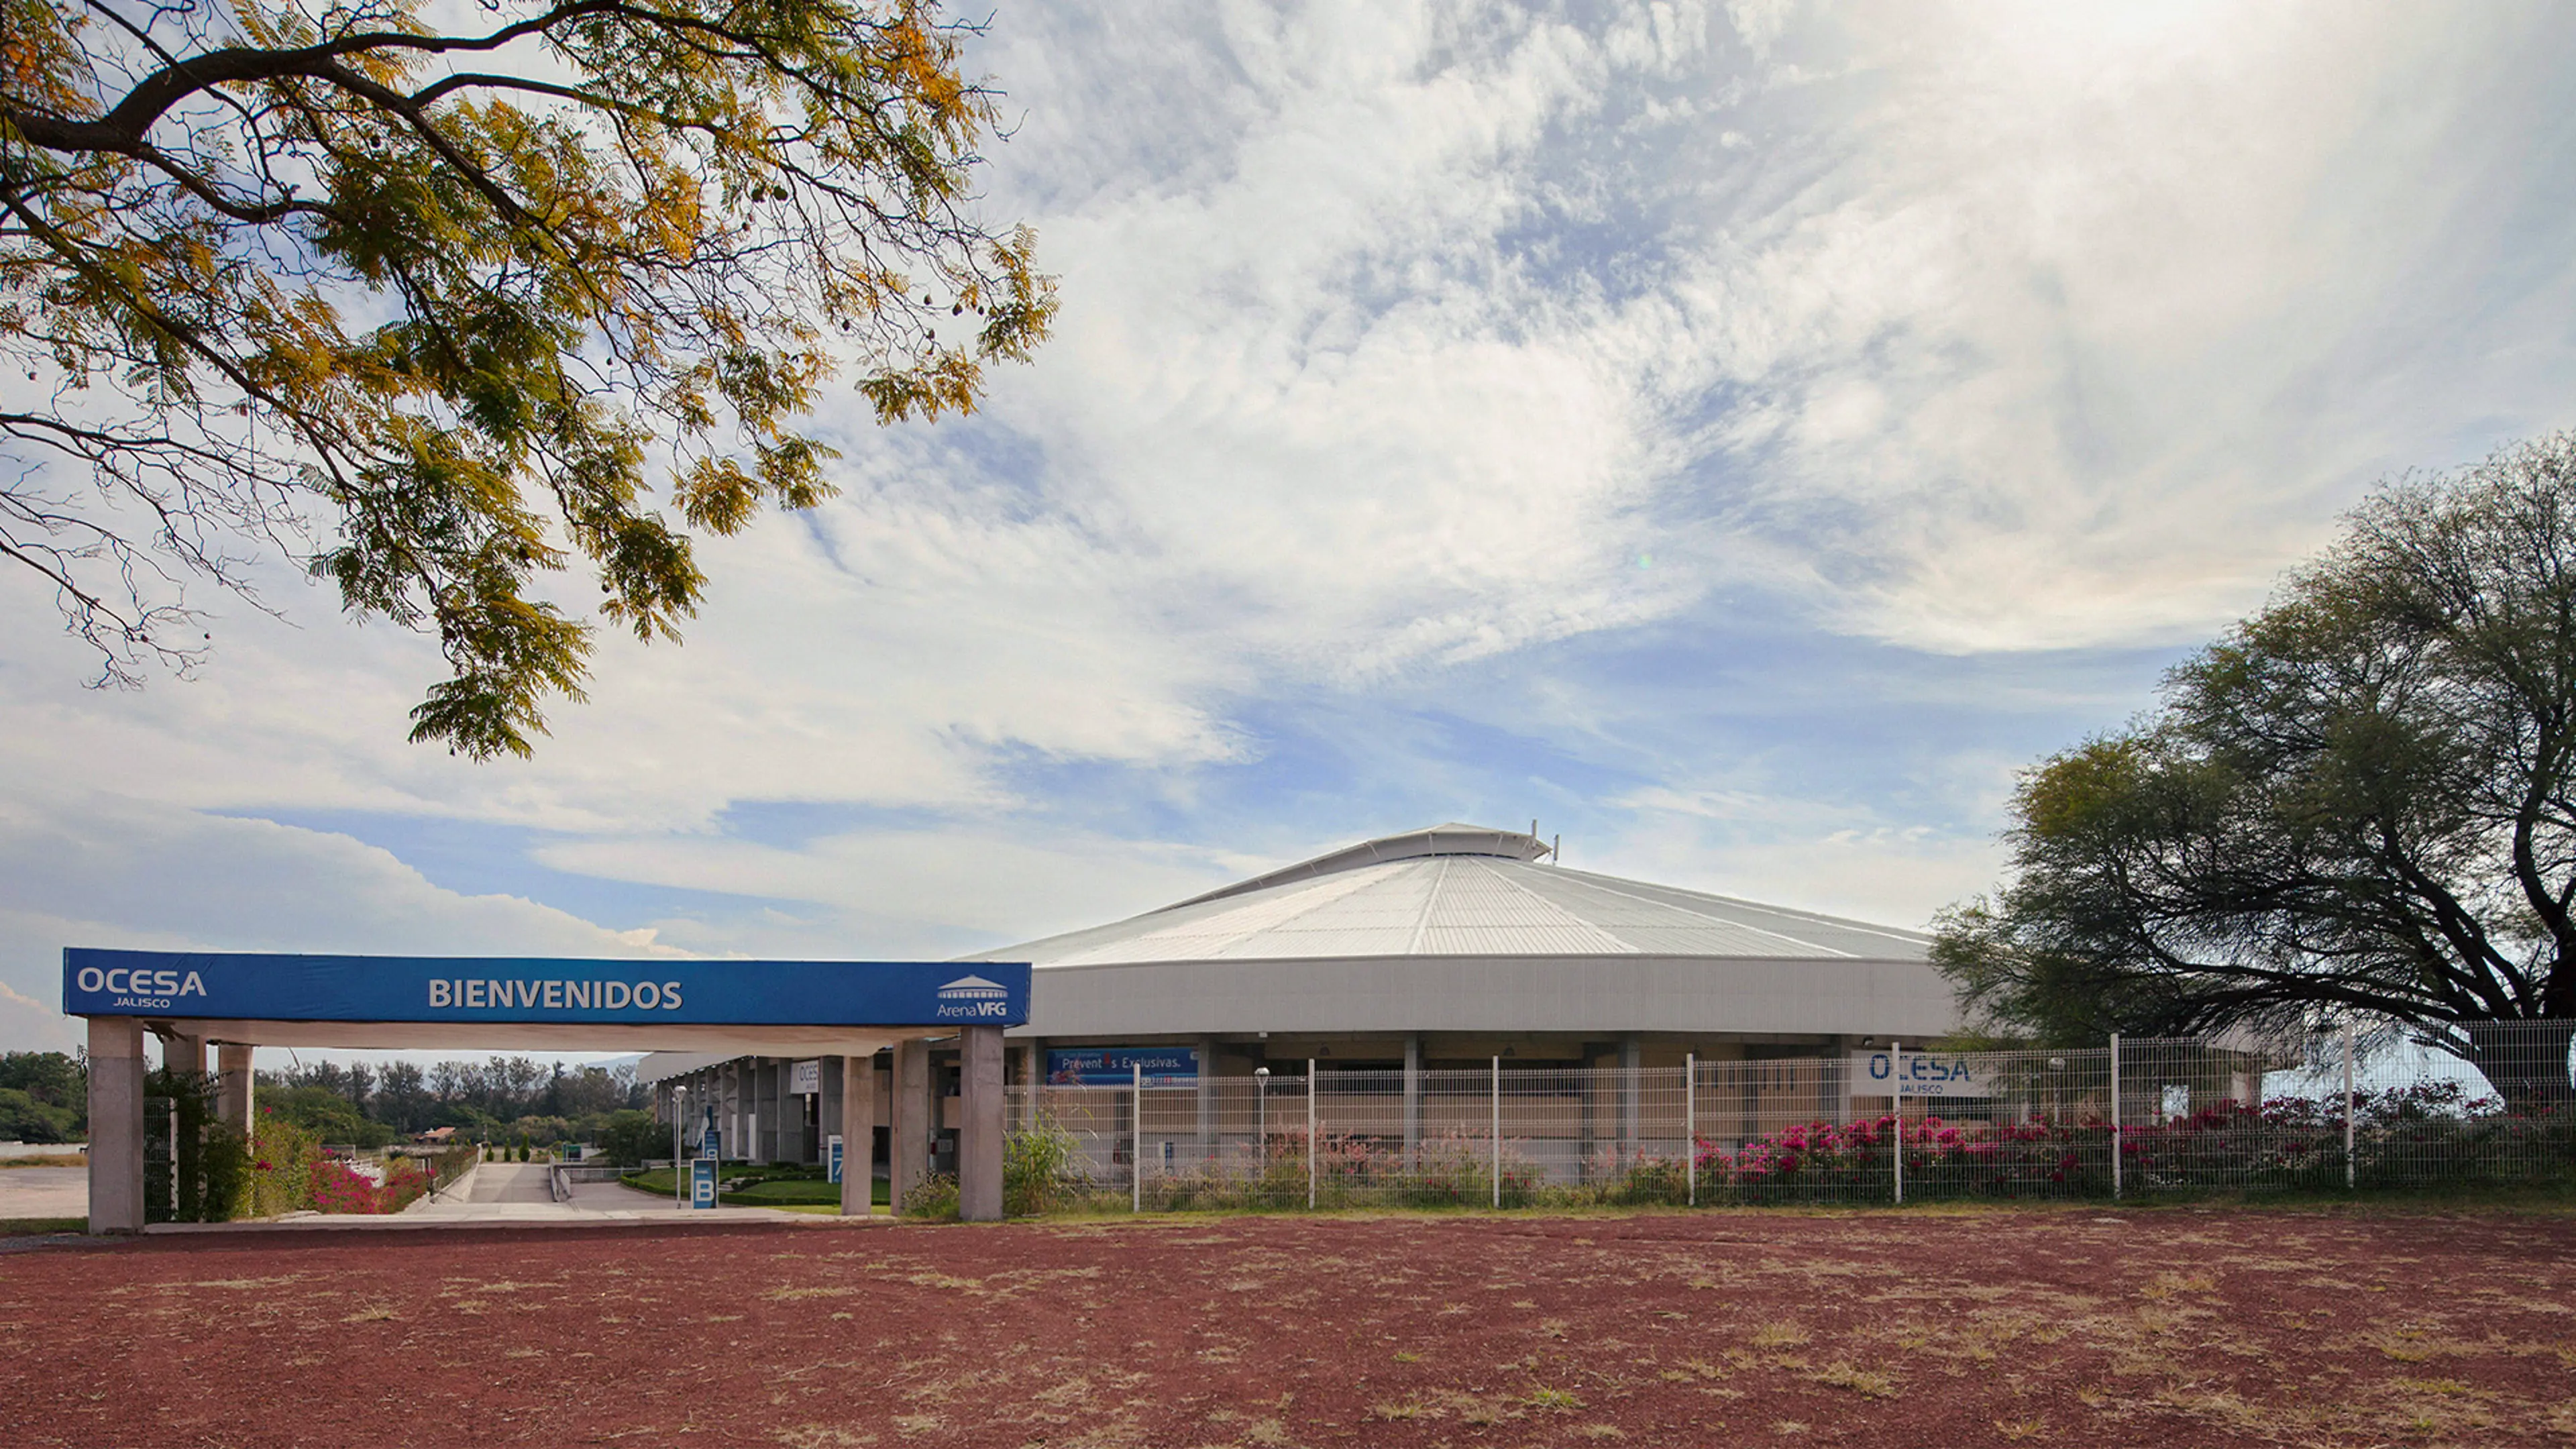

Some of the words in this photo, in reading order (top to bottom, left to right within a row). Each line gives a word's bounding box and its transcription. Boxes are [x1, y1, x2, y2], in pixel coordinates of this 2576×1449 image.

[77, 967, 207, 996] OCESA
[429, 979, 684, 1010] BIENVENIDOS
[113, 997, 170, 1008] JALISCO
[696, 1179, 714, 1202] B
